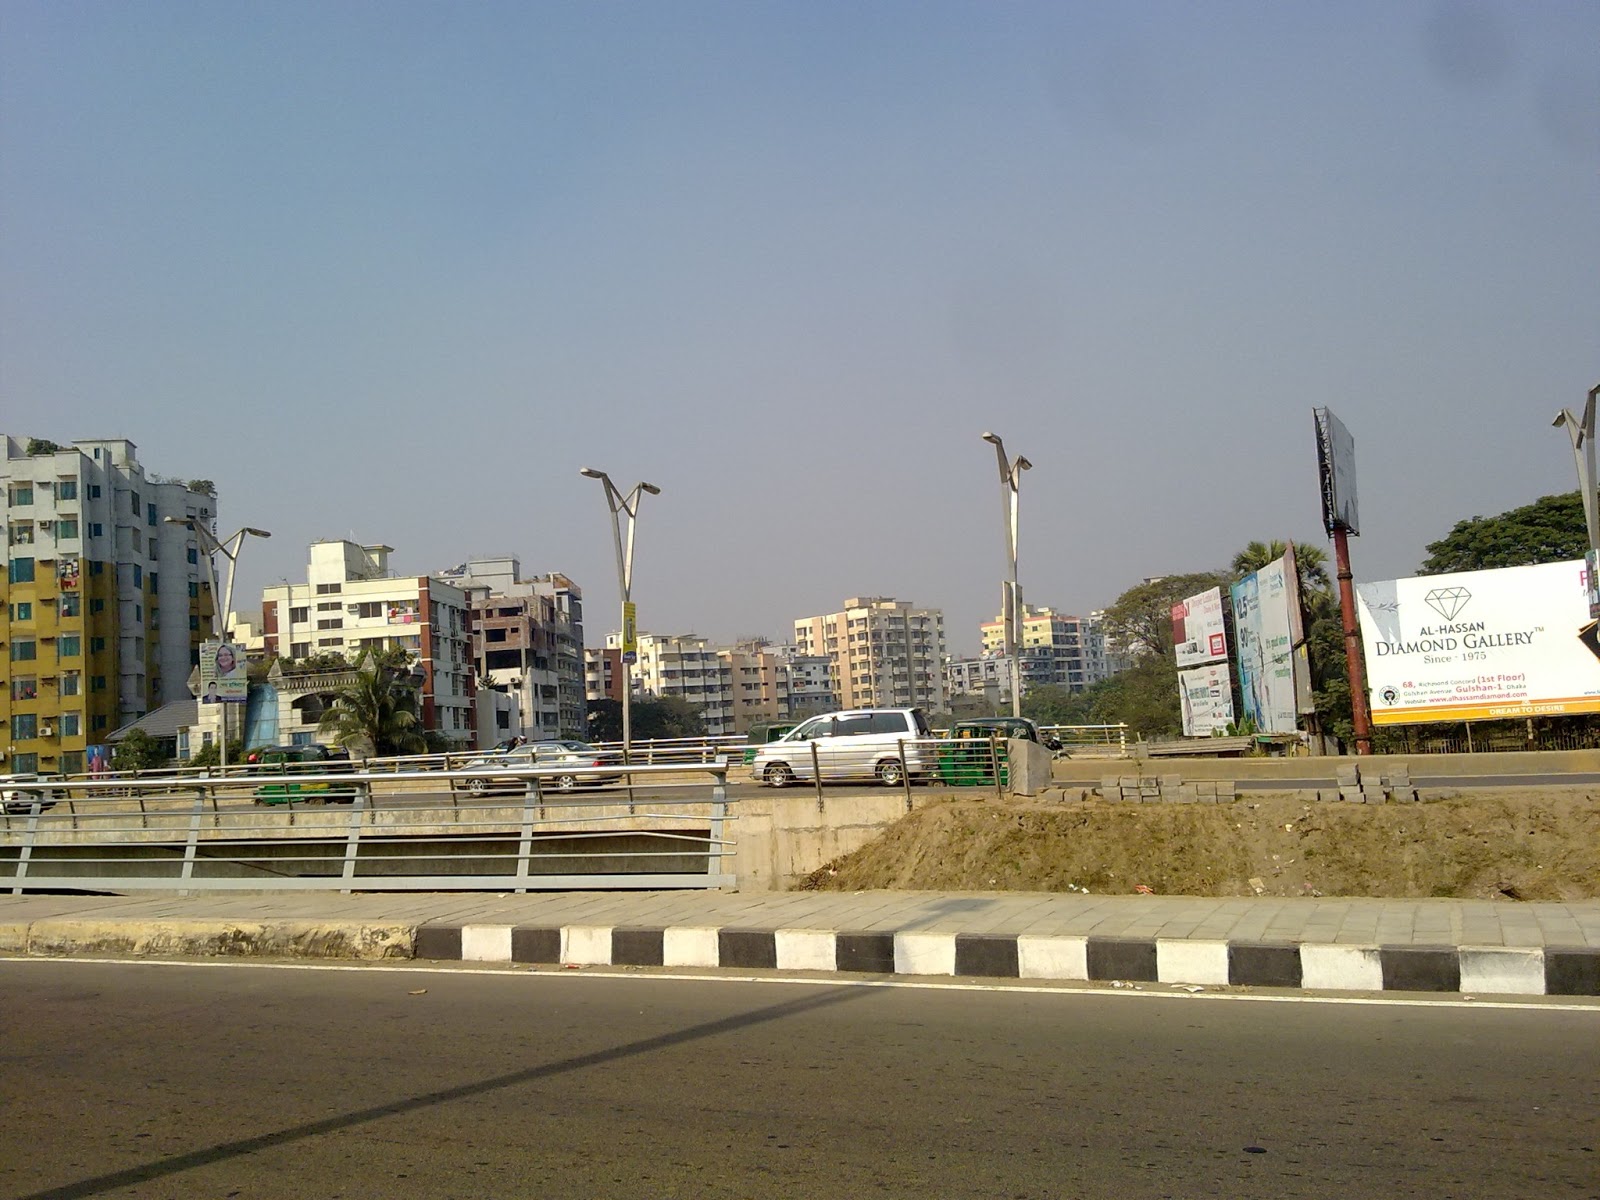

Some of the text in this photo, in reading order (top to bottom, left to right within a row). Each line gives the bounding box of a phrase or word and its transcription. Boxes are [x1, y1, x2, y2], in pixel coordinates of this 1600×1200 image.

[1420, 622, 1485, 636] AL-HASSAN
[1375, 638, 1458, 656] DIAMOND
[1463, 631, 1534, 649] GALLERY
[1423, 654, 1452, 664] Since
[1462, 651, 1487, 661] 1975
[1402, 681, 1416, 689] 68,
[1477, 676, 1495, 684] (1st
[1497, 673, 1526, 682] Floor)
[1455, 684, 1503, 693] Gulshan-1
[1489, 703, 1566, 715] DREAM TO DESIRE
